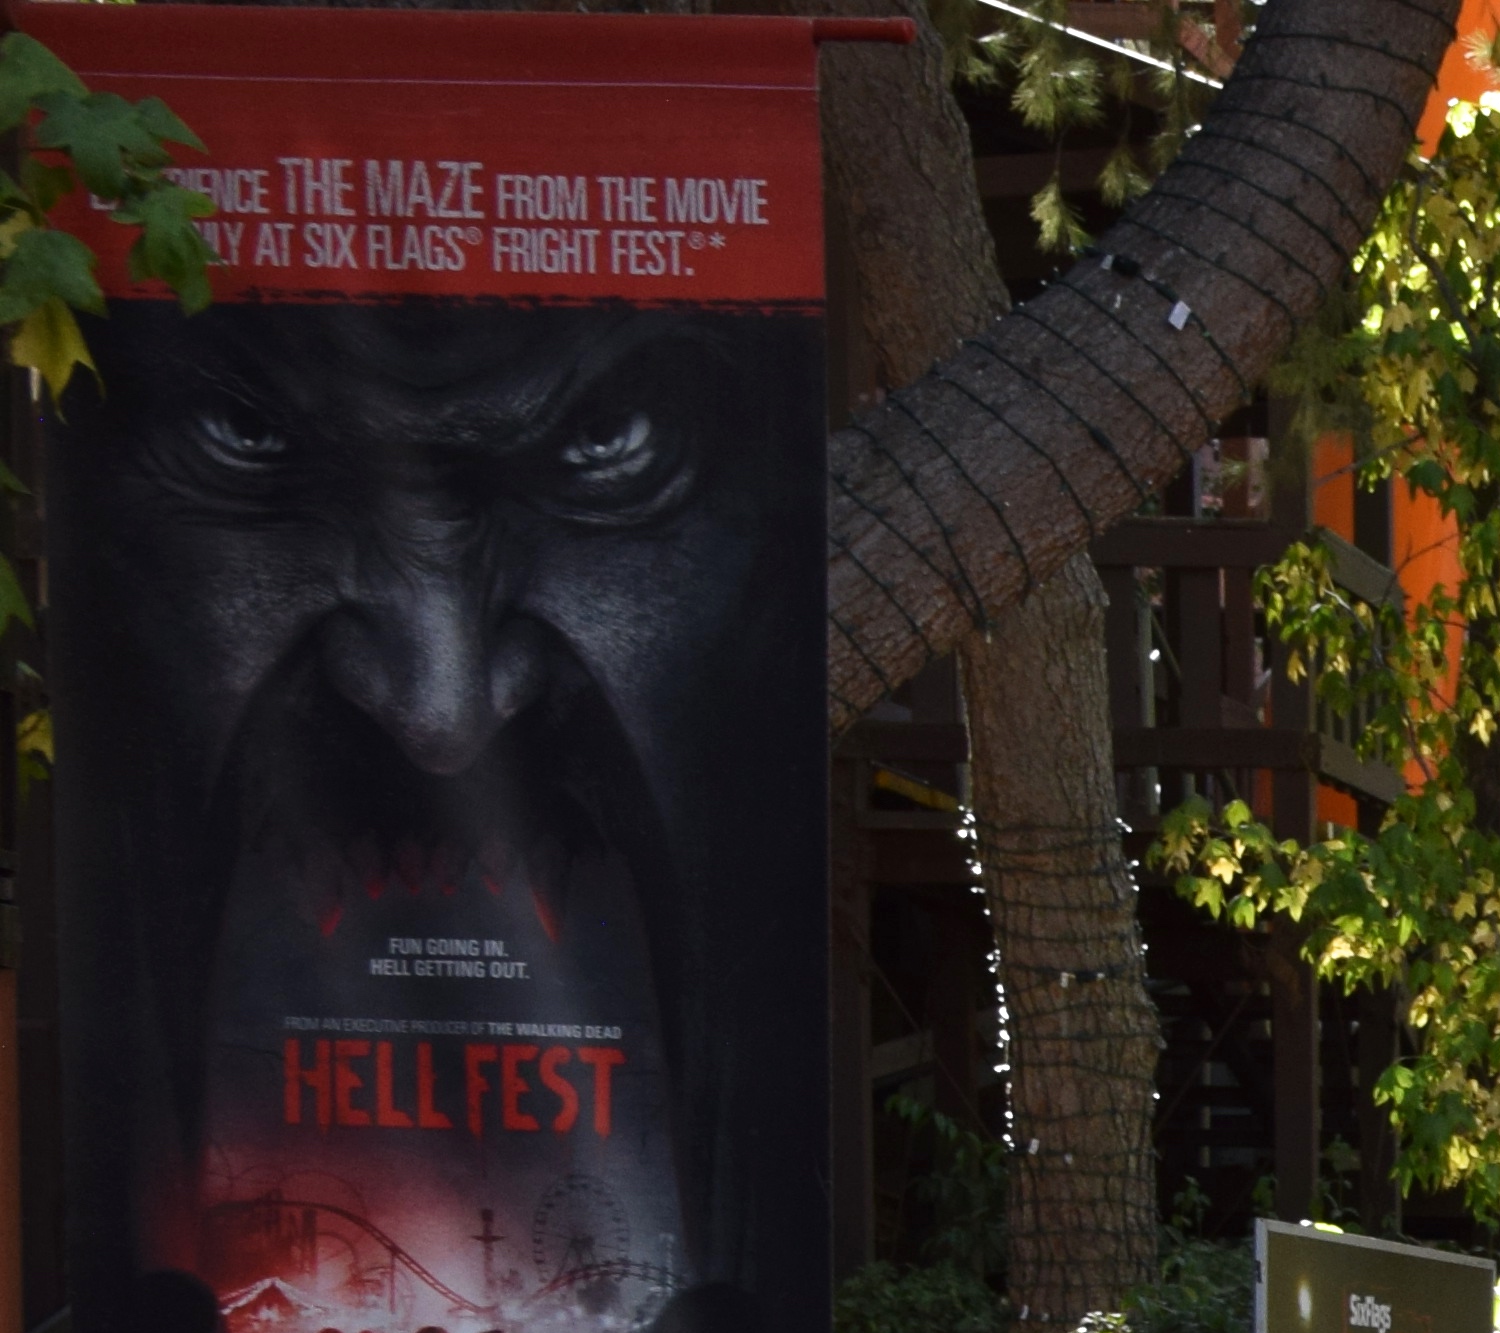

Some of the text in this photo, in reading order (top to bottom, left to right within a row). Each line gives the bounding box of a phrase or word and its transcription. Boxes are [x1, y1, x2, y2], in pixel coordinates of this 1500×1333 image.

[277, 156, 357, 218] THE
[364, 158, 485, 220] MAZE
[496, 173, 589, 222] FROM
[596, 175, 658, 223] THE
[665, 176, 770, 226] MOVIE
[254, 222, 296, 267] AT
[302, 222, 358, 270] SIX
[491, 226, 601, 275] FRIGHT
[388, 937, 509, 957] FUN GOING IN.
[369, 958, 531, 980] HELL GETTING OUT.
[487, 1021, 514, 1036] THE
[516, 1022, 583, 1039] WALKING
[584, 1024, 622, 1040] DEAD
[283, 1036, 627, 1142] HELL FEST
